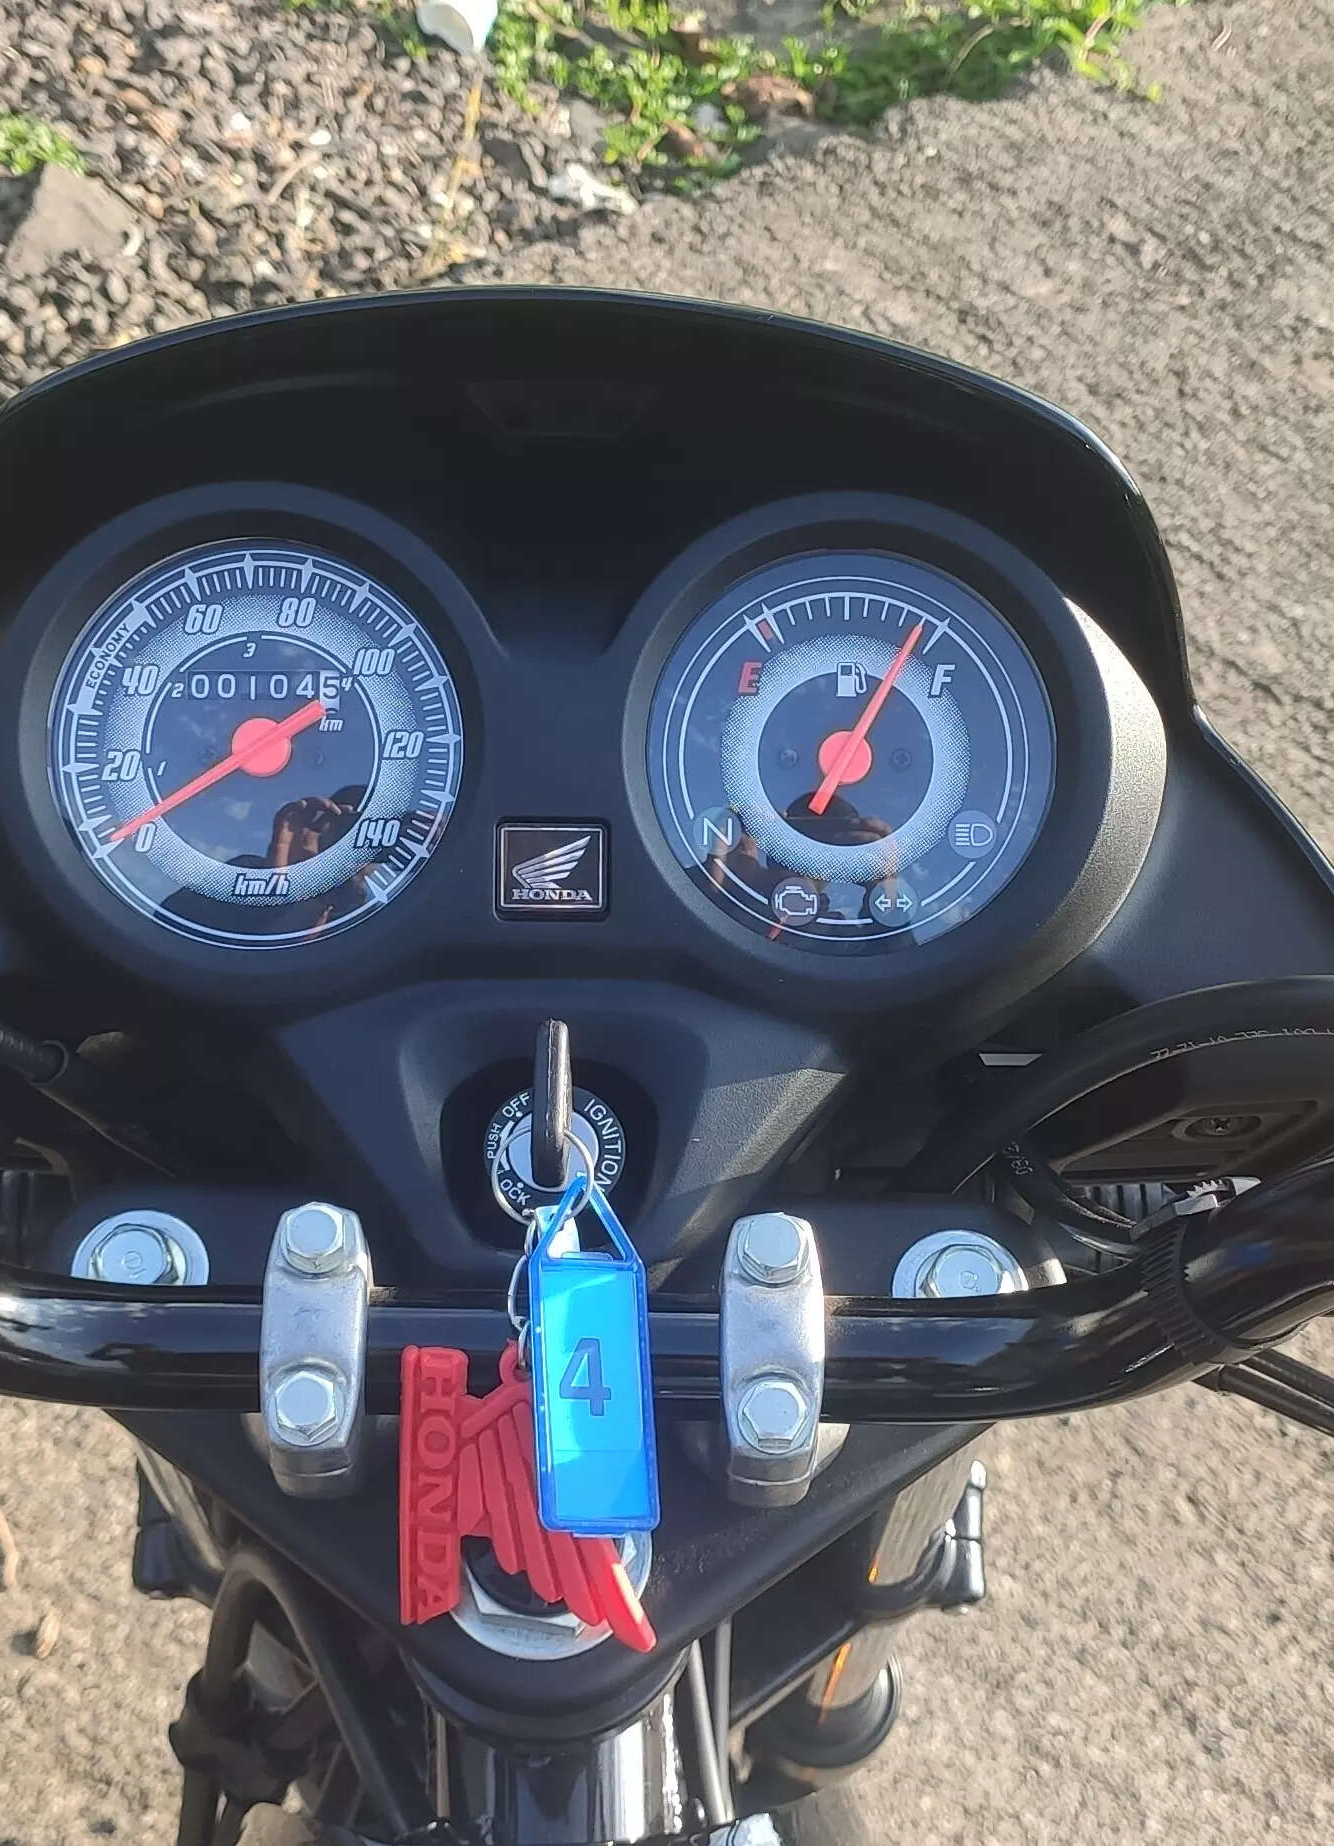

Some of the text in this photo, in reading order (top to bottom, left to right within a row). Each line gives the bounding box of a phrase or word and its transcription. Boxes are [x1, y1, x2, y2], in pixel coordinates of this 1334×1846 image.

[184, 604, 224, 634] 60
[278, 597, 318, 628] 80
[85, 623, 130, 689] ECONOMY
[243, 643, 257, 658] 3
[353, 648, 395, 676] 100
[121, 664, 159, 695] 40
[170, 682, 185, 698] 2
[341, 676, 354, 692] 4
[737, 660, 763, 695] E
[931, 663, 956, 697] F
[319, 716, 344, 732] km
[382, 731, 425, 759] 120
[101, 750, 142, 781] 20
[135, 822, 157, 853] 0
[355, 820, 401, 849] 140
[701, 817, 735, 848] N
[233, 873, 290, 896] km/h
[511, 888, 593, 901] HONDA
[501, 1091, 530, 1119] OFF
[486, 1121, 502, 1160] PUSH
[583, 1098, 623, 1194] IGNITION
[559, 1337, 613, 1418] 4
[416, 1350, 458, 1612] HONDA
